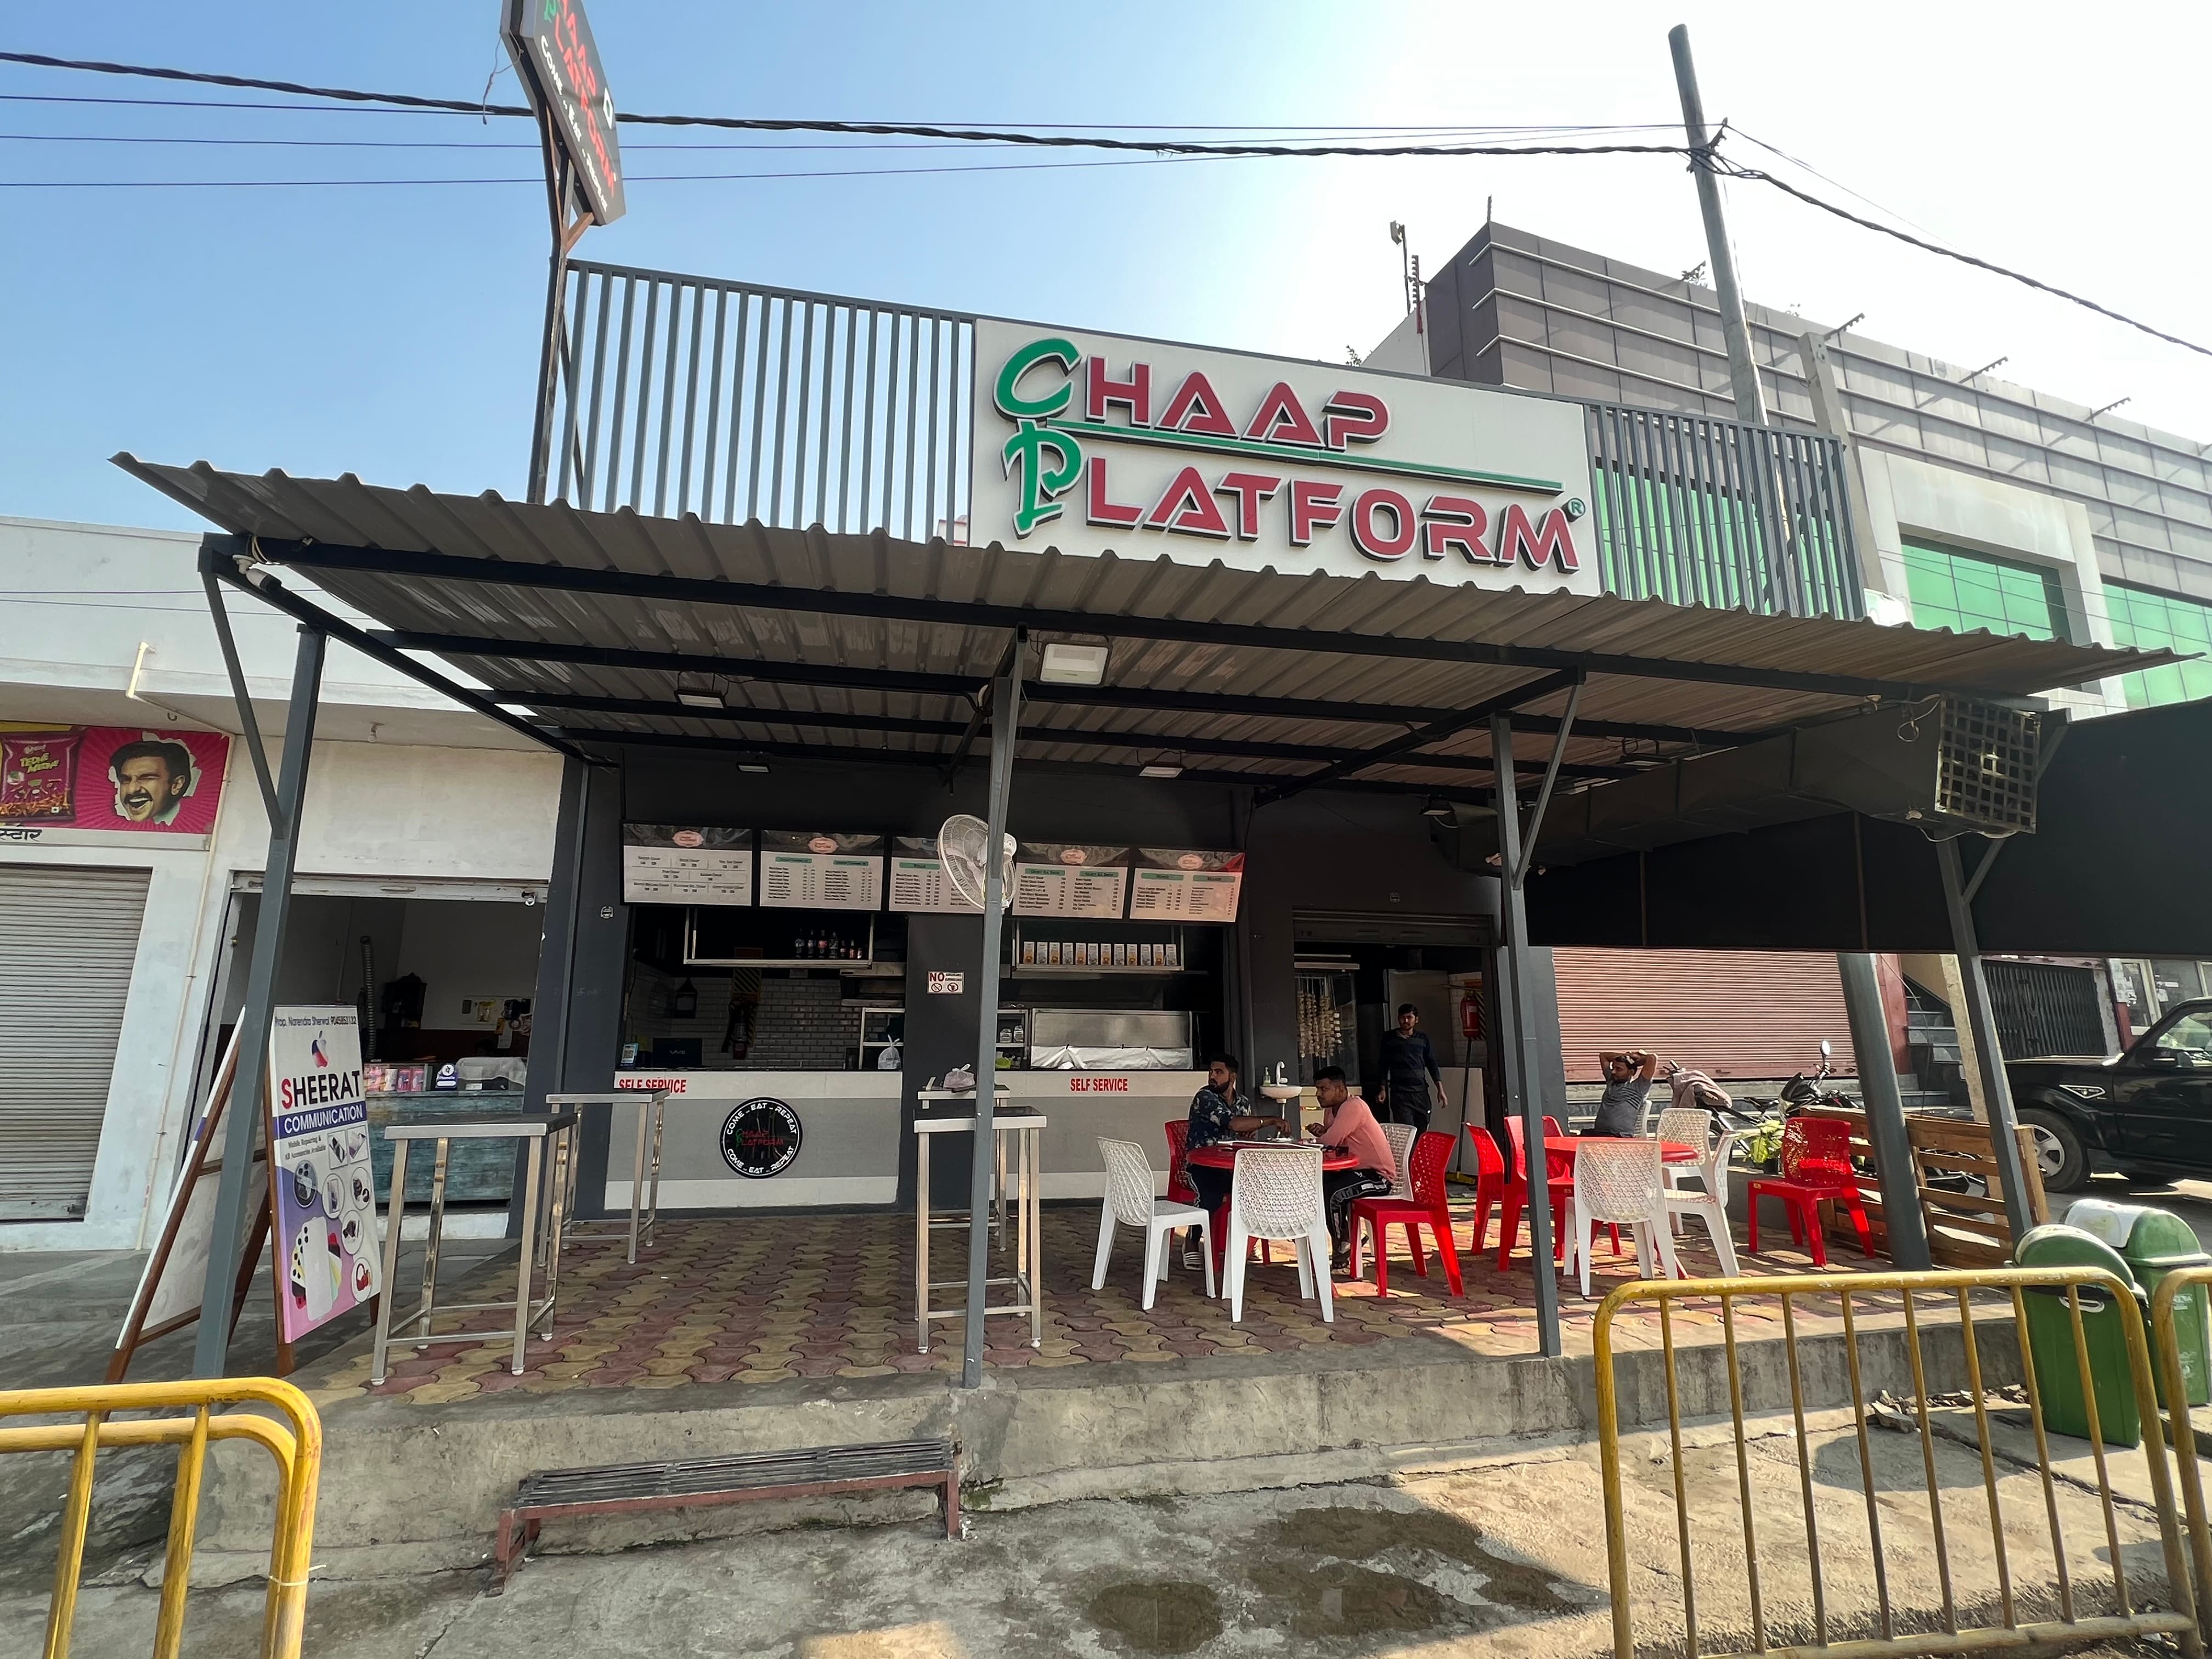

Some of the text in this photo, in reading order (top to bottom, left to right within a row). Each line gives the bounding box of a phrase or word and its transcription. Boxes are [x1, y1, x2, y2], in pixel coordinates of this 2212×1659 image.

[993, 337, 1391, 451] CHAAP
[1002, 418, 1580, 574] PLATFORM
[929, 972, 945, 982] NO
[281, 1070, 360, 1109] SHEERAT
[646, 1079, 687, 1093] SERVICE
[1070, 1078, 1128, 1091] SELF SERVICE
[284, 1104, 363, 1134] COMMUNICATION
[727, 1111, 744, 1135] COME
[775, 1106, 797, 1134] REPEAT
[727, 1149, 744, 1168] COME
[770, 1146, 794, 1170] REPEAT
